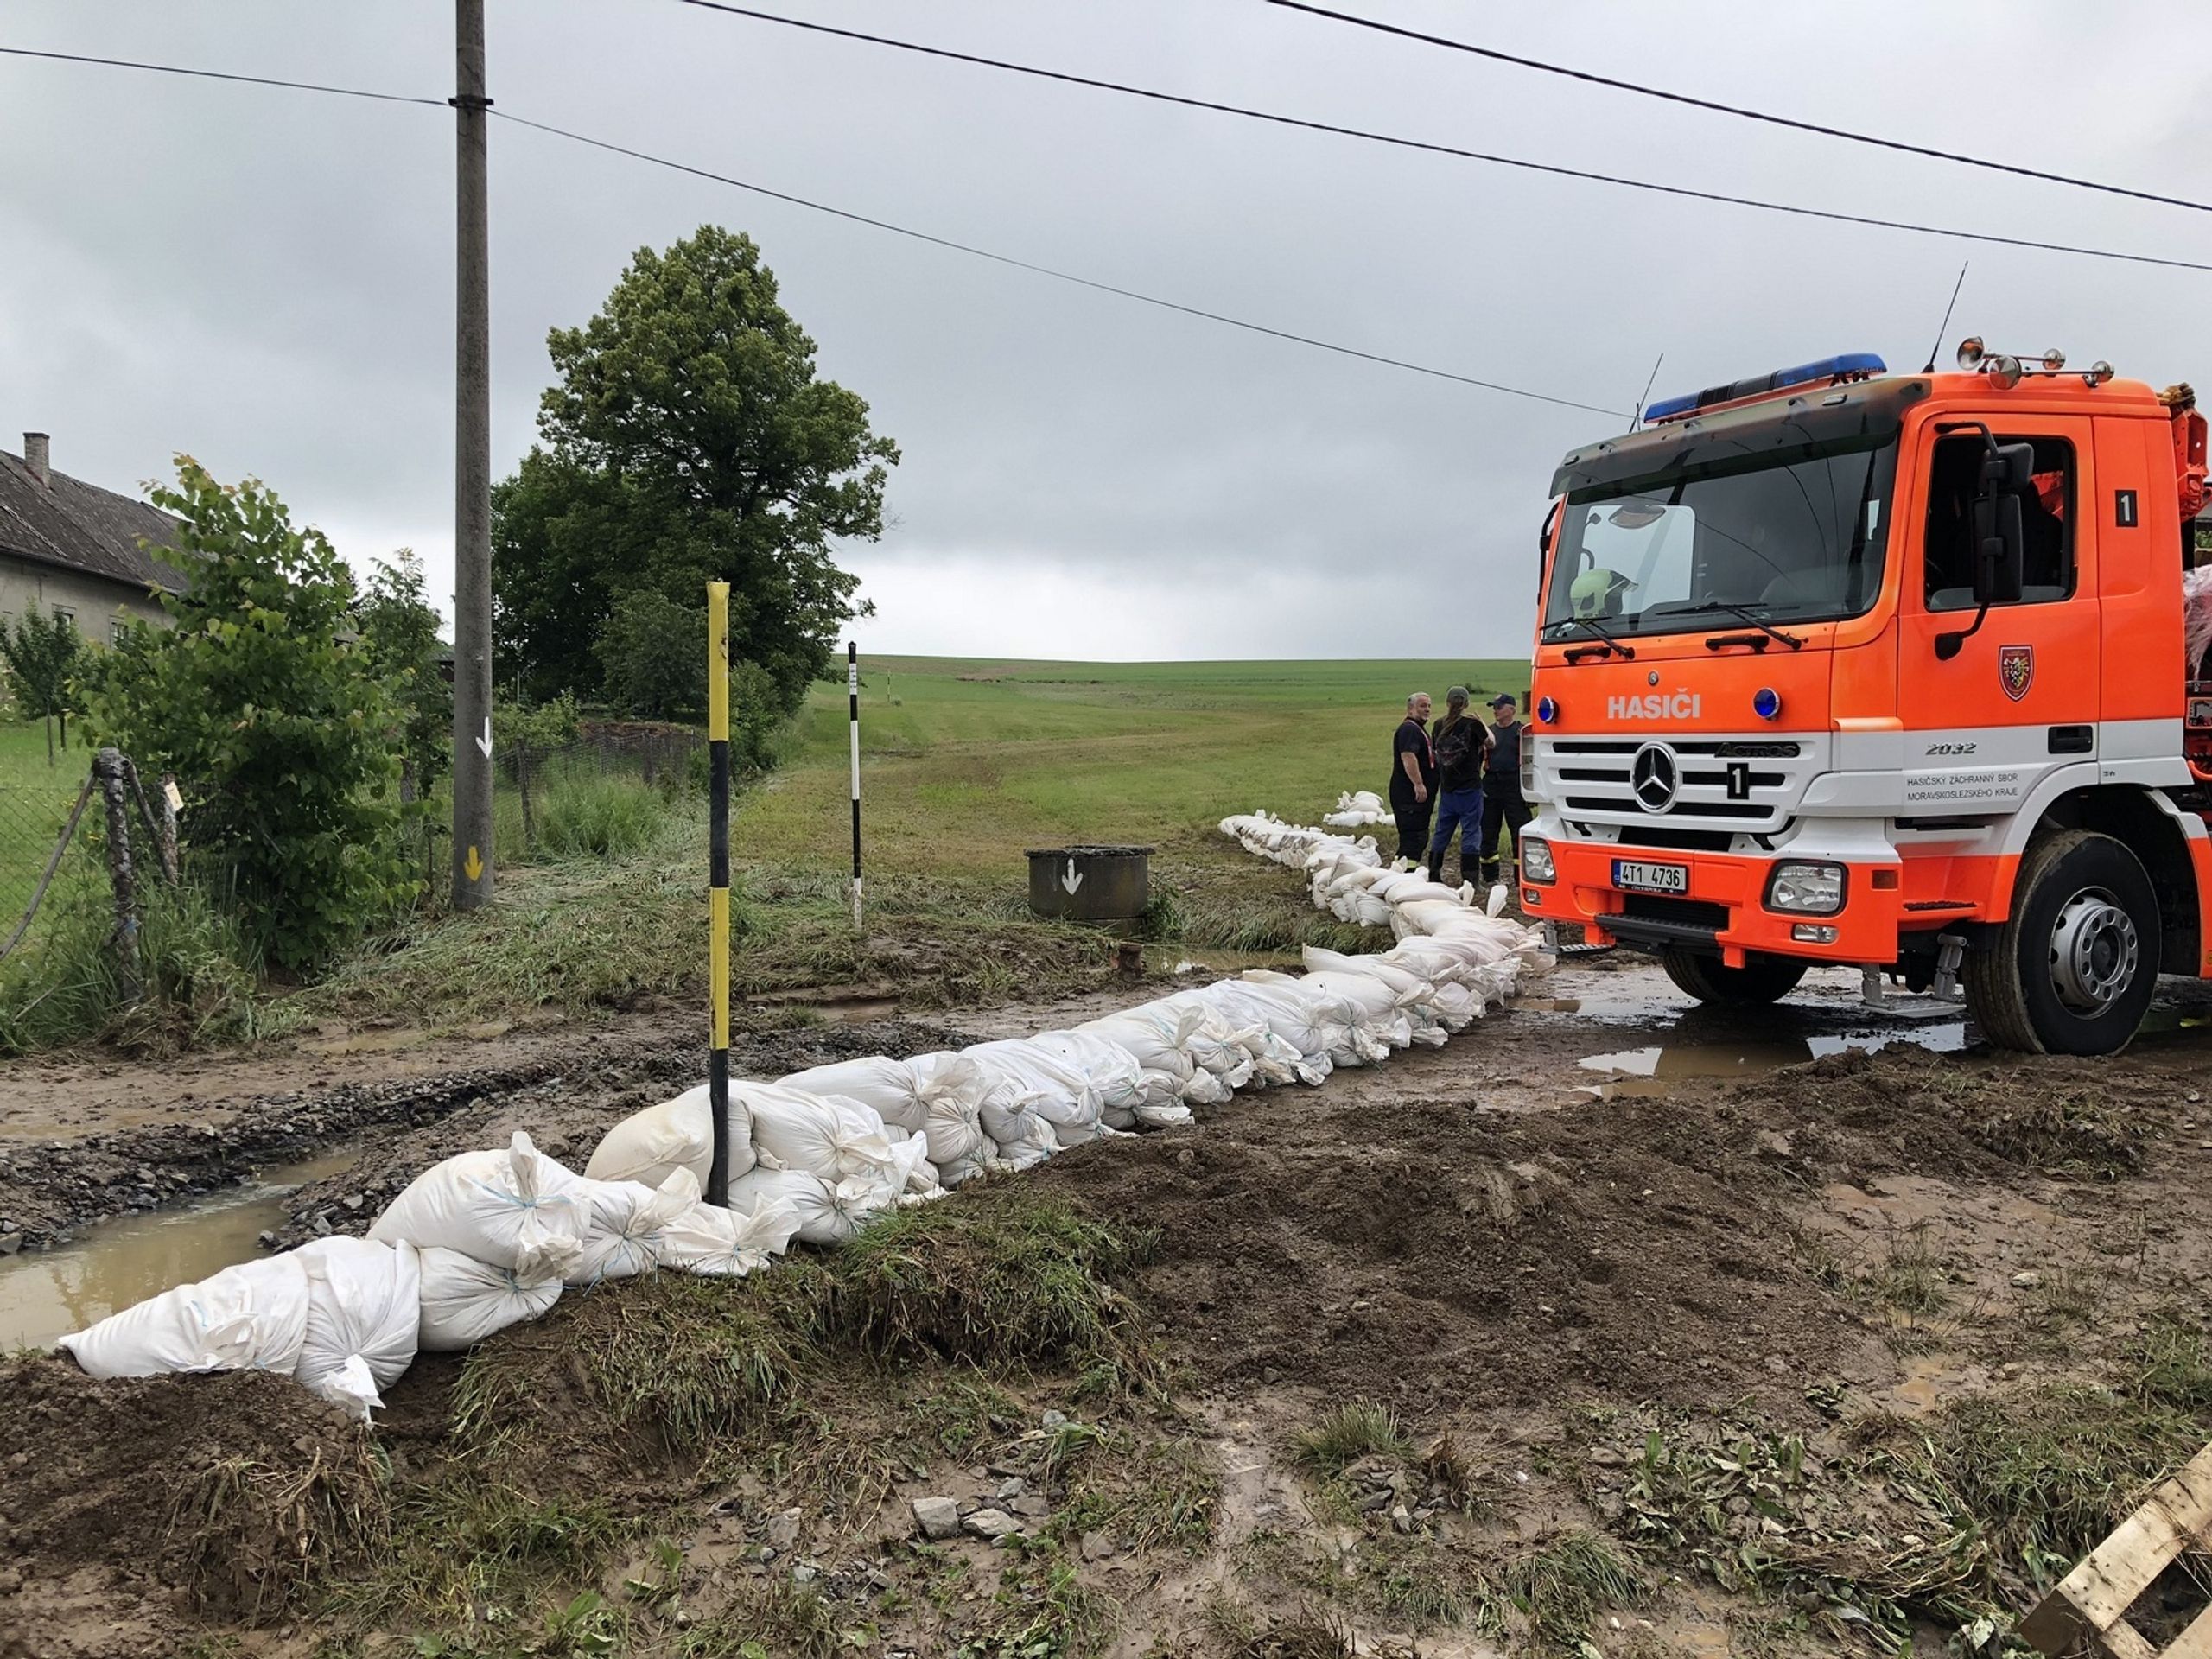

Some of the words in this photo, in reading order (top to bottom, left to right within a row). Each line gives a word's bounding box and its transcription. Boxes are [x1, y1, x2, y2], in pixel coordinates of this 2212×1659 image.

[2120, 494, 2131, 522] 1
[1607, 687, 1700, 719] HASIČI
[1925, 742, 1977, 756] 2032
[1732, 767, 1742, 794] 1
[1907, 776, 1946, 786] HASIČSKÝ
[1998, 772, 2018, 782] SBOR
[1995, 787, 2018, 797] KRAJE
[1623, 864, 1643, 883] 4T1
[1651, 867, 1681, 887] 4736
